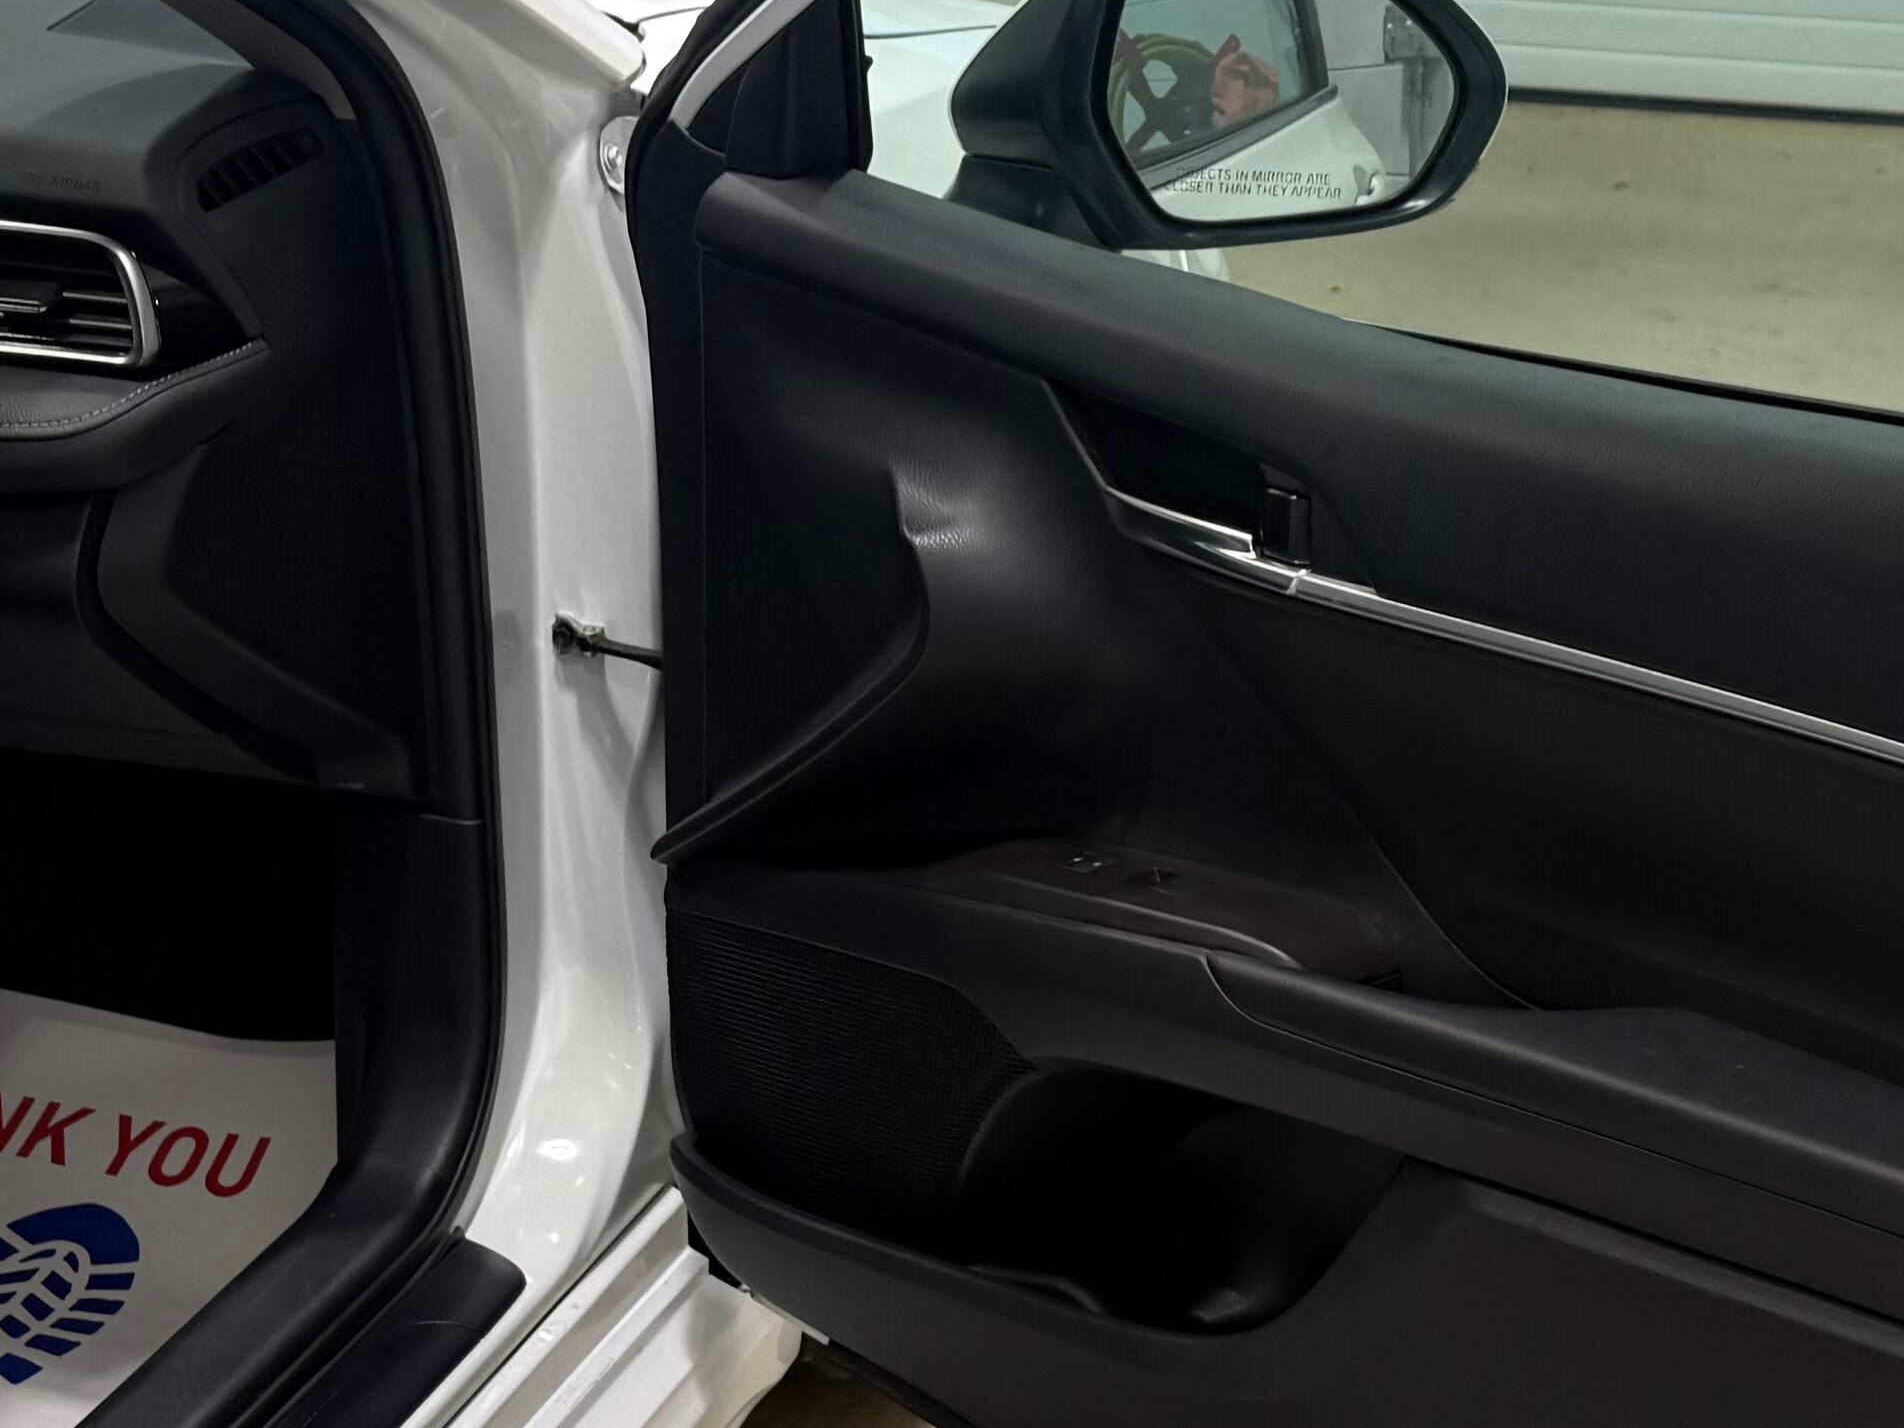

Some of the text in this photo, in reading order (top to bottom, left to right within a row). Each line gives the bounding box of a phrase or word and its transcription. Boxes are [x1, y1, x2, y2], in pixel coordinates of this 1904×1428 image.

[1235, 169, 1249, 182] IN
[1251, 169, 1303, 184] MIRROR
[1306, 172, 1331, 186] ARE
[1218, 181, 1252, 195] THAN
[1256, 183, 1288, 197] THEY
[1290, 185, 1342, 201] APPEAR
[106, 1112, 272, 1198] YOU
